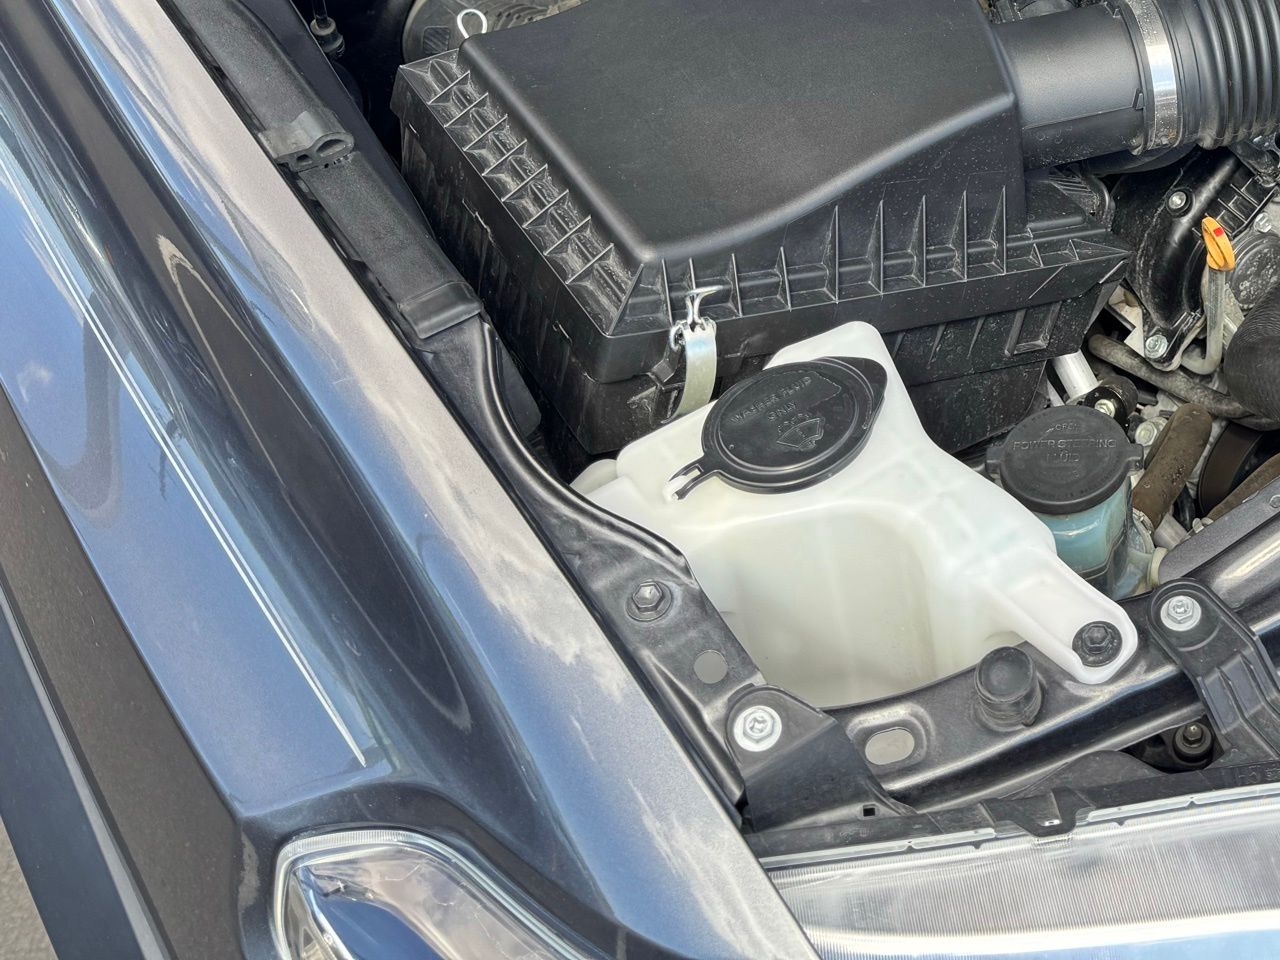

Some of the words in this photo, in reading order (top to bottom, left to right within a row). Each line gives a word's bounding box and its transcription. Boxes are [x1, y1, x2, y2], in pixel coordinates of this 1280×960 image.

[730, 392, 779, 425] WASHER
[767, 401, 797, 423] ONLY
[1012, 439, 1056, 451] POWER
[1056, 439, 1118, 449] STEERING
